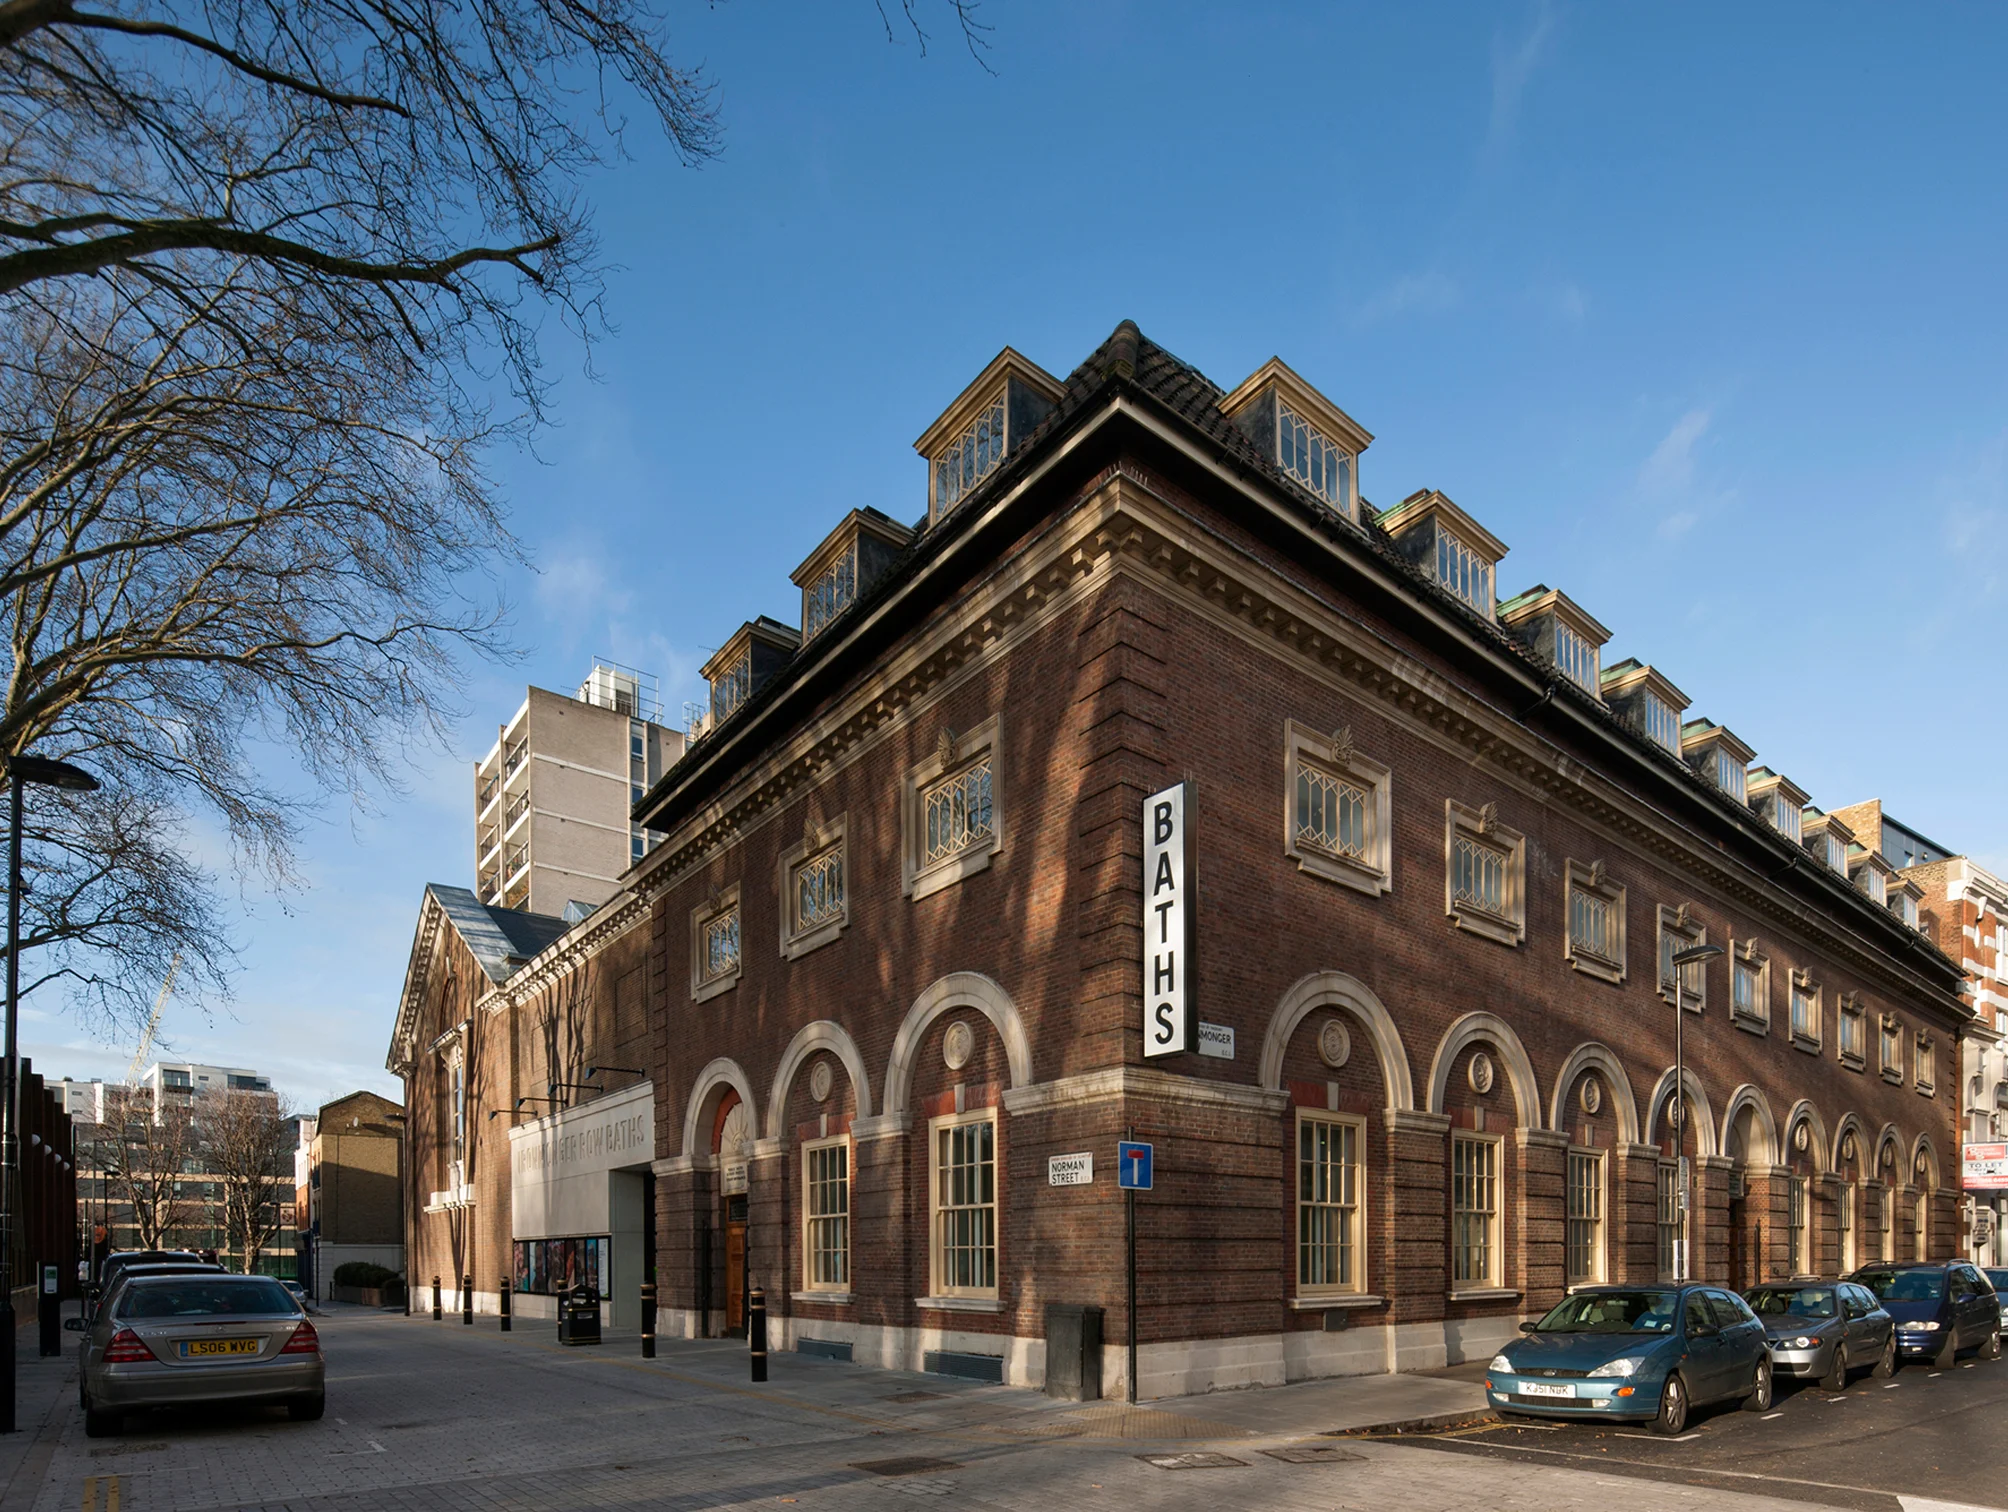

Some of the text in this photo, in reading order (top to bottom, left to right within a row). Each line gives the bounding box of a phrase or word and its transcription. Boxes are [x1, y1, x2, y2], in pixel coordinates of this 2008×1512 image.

[1153, 800, 1175, 1046] BATHS
[517, 1114, 645, 1175] IRONMONGER ROW BATHS
[1051, 1160, 1085, 1173] NORMAN
[1985, 1161, 2004, 1169] LET
[1051, 1172, 1080, 1184] STREET
[190, 1340, 256, 1355] LS06 WVG
